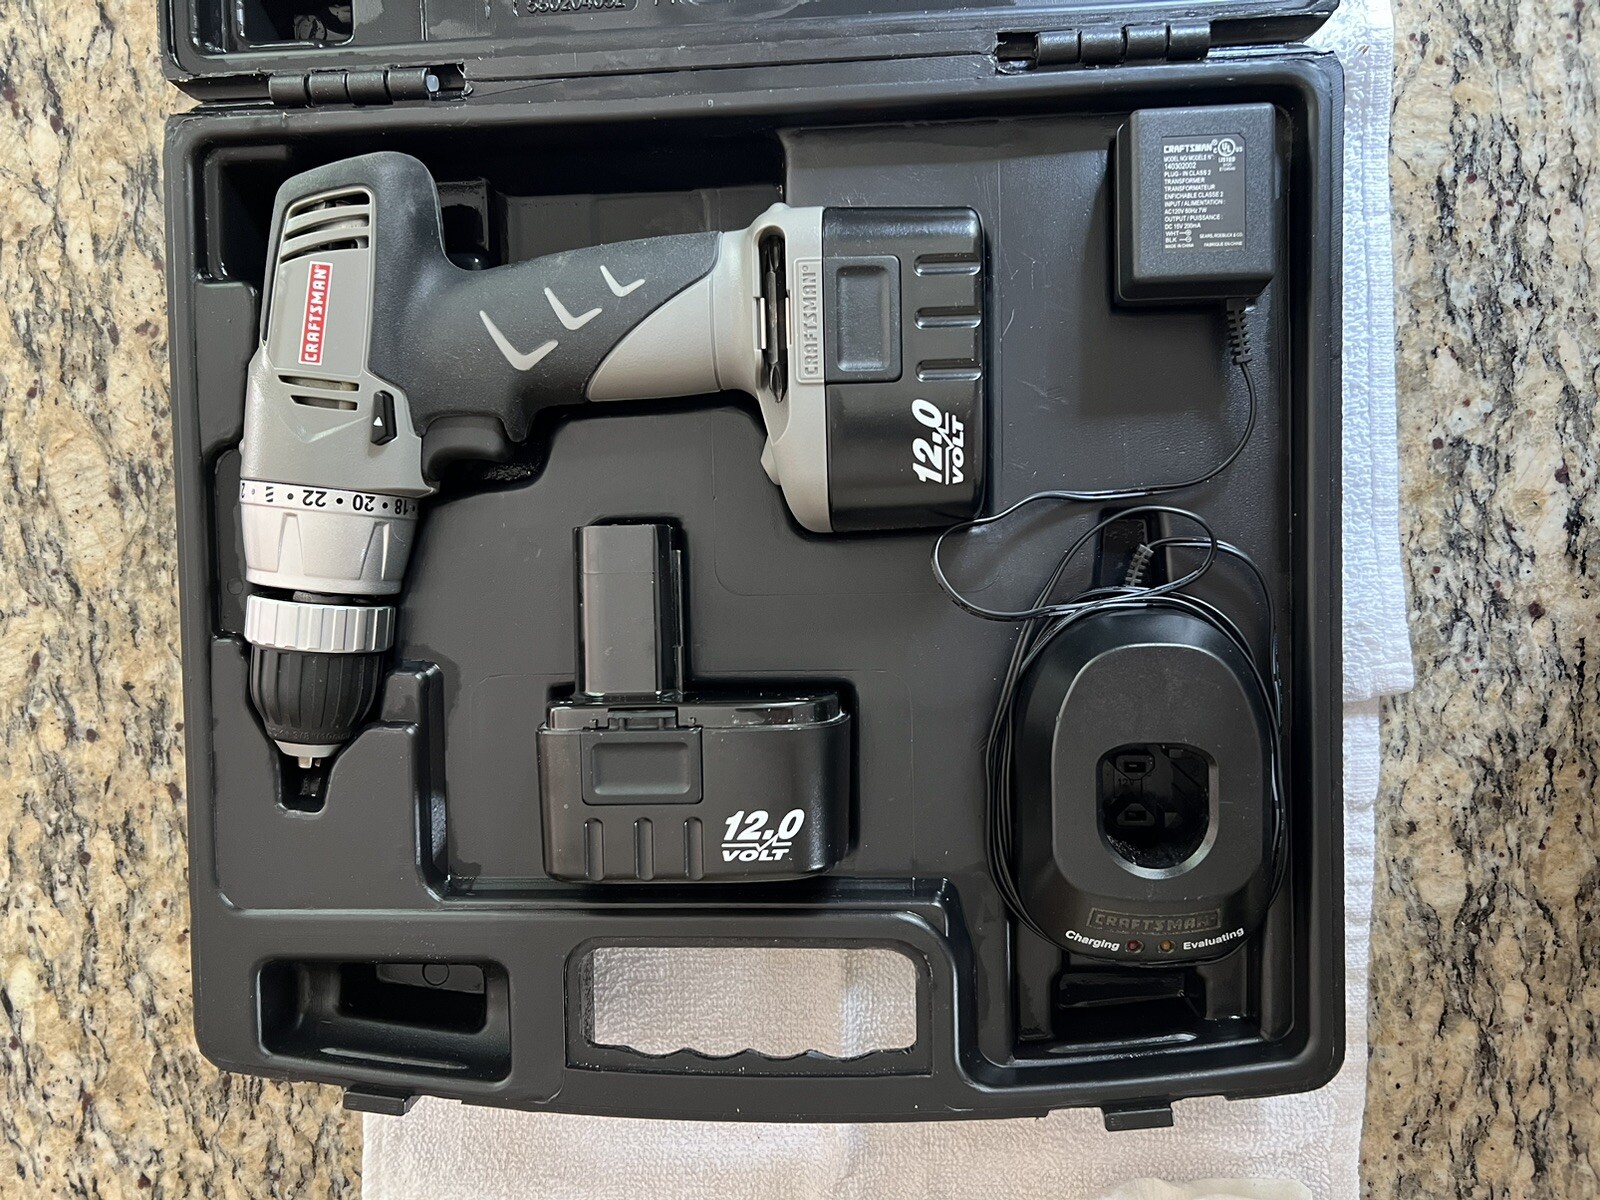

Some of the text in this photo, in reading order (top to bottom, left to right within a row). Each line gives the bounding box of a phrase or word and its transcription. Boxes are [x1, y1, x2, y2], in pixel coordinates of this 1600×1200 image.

[1163, 144, 1212, 153] CRAFTSMAN
[1164, 177, 1206, 185] TRANSFORMER
[1164, 184, 1216, 192] TRANSFORMATEUR
[1164, 192, 1197, 200] ENFICHABLE
[304, 268, 327, 361] CRAFTSMAN
[801, 270, 818, 376] CRAFTSMAN
[911, 399, 943, 484] 12.0
[952, 415, 965, 484] VOLT
[302, 489, 327, 508] 22
[352, 494, 376, 512] 20
[394, 498, 408, 516] 18
[723, 808, 805, 841] 12.0
[722, 848, 790, 862] VOLT
[1095, 914, 1211, 932] CRAFTSMAN
[1065, 930, 1120, 952] Charging
[1183, 927, 1245, 950] Evaluating
